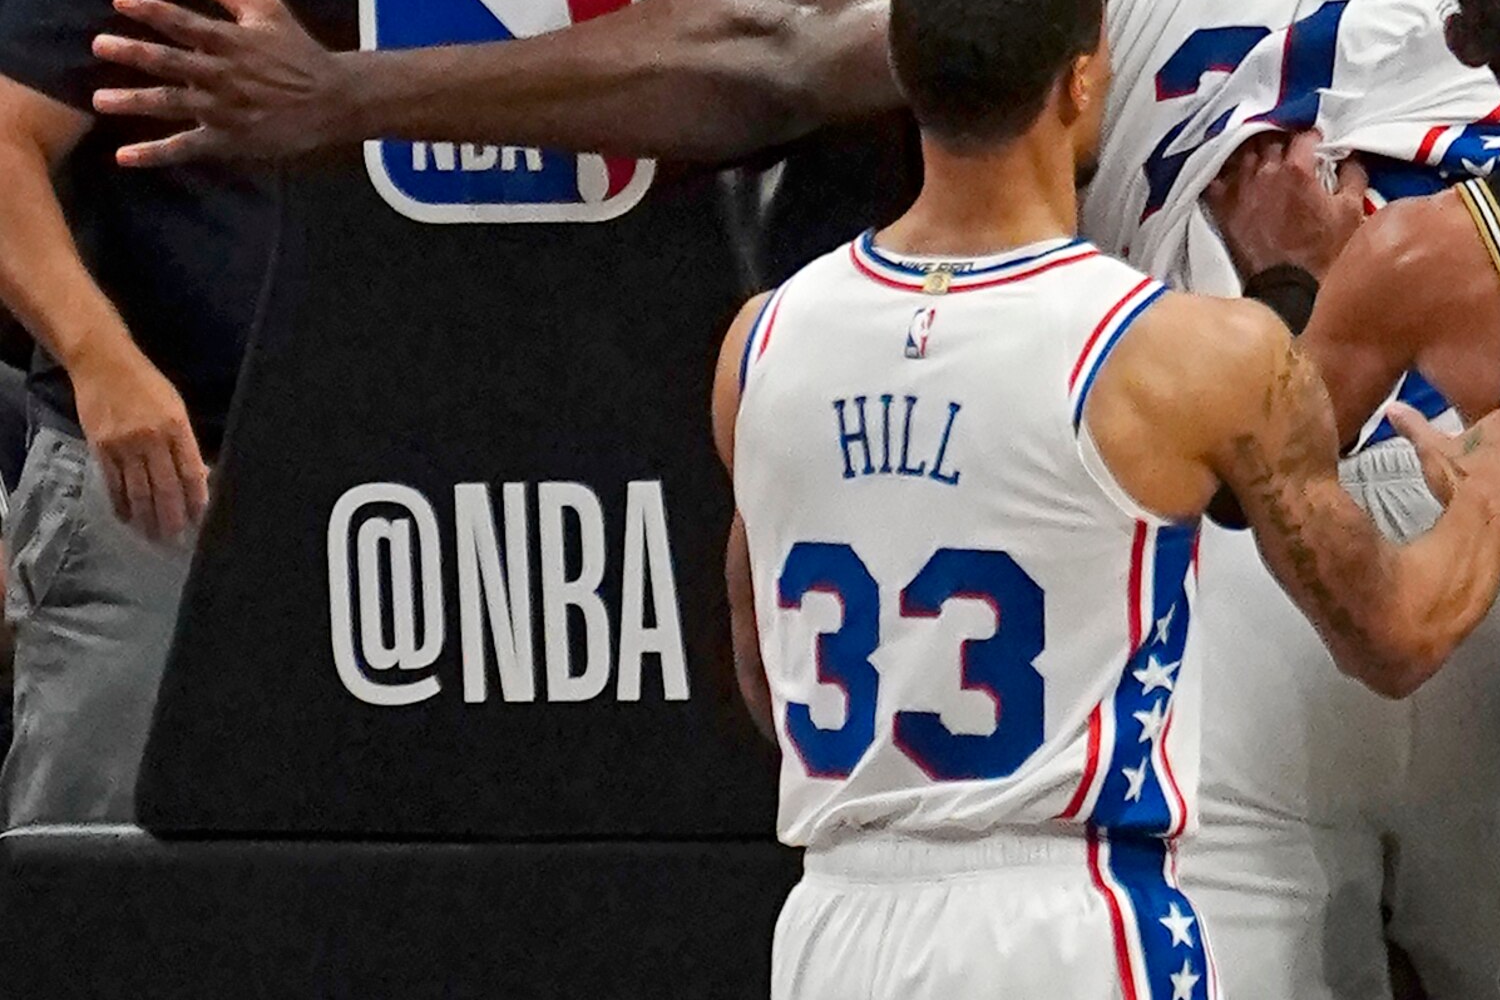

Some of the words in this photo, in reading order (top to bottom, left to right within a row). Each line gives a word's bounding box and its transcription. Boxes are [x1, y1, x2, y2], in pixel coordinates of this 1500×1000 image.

[832, 394, 962, 486] HILL
[326, 480, 691, 707] @NBA
[776, 541, 1046, 782] 33
